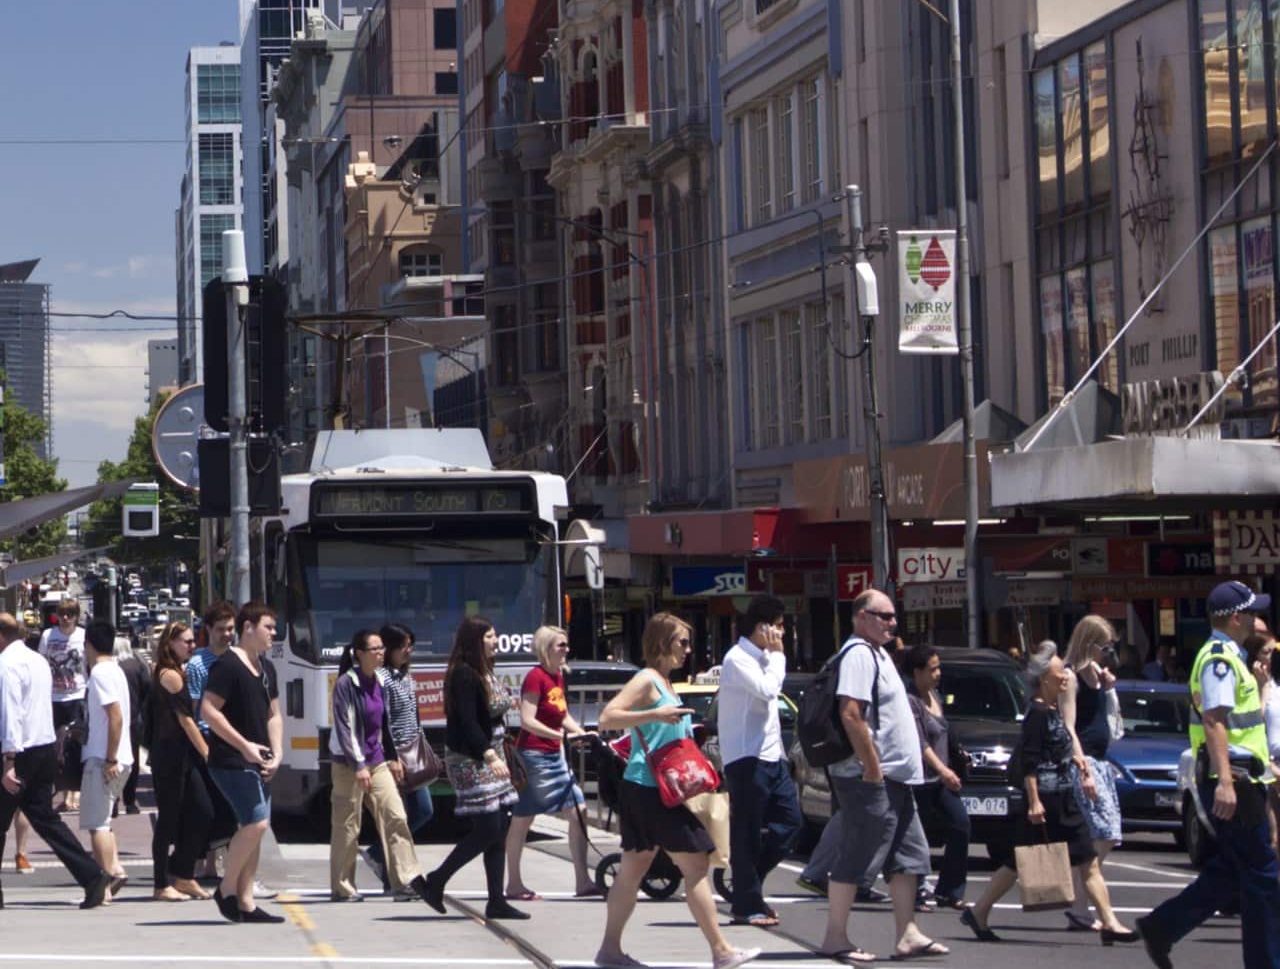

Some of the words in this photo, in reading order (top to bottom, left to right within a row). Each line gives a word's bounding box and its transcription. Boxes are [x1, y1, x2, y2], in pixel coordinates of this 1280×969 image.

[905, 301, 952, 314] MERRY
[1129, 342, 1150, 367] PORT
[1161, 333, 1197, 362] PHILLIP
[494, 634, 534, 653] 095
